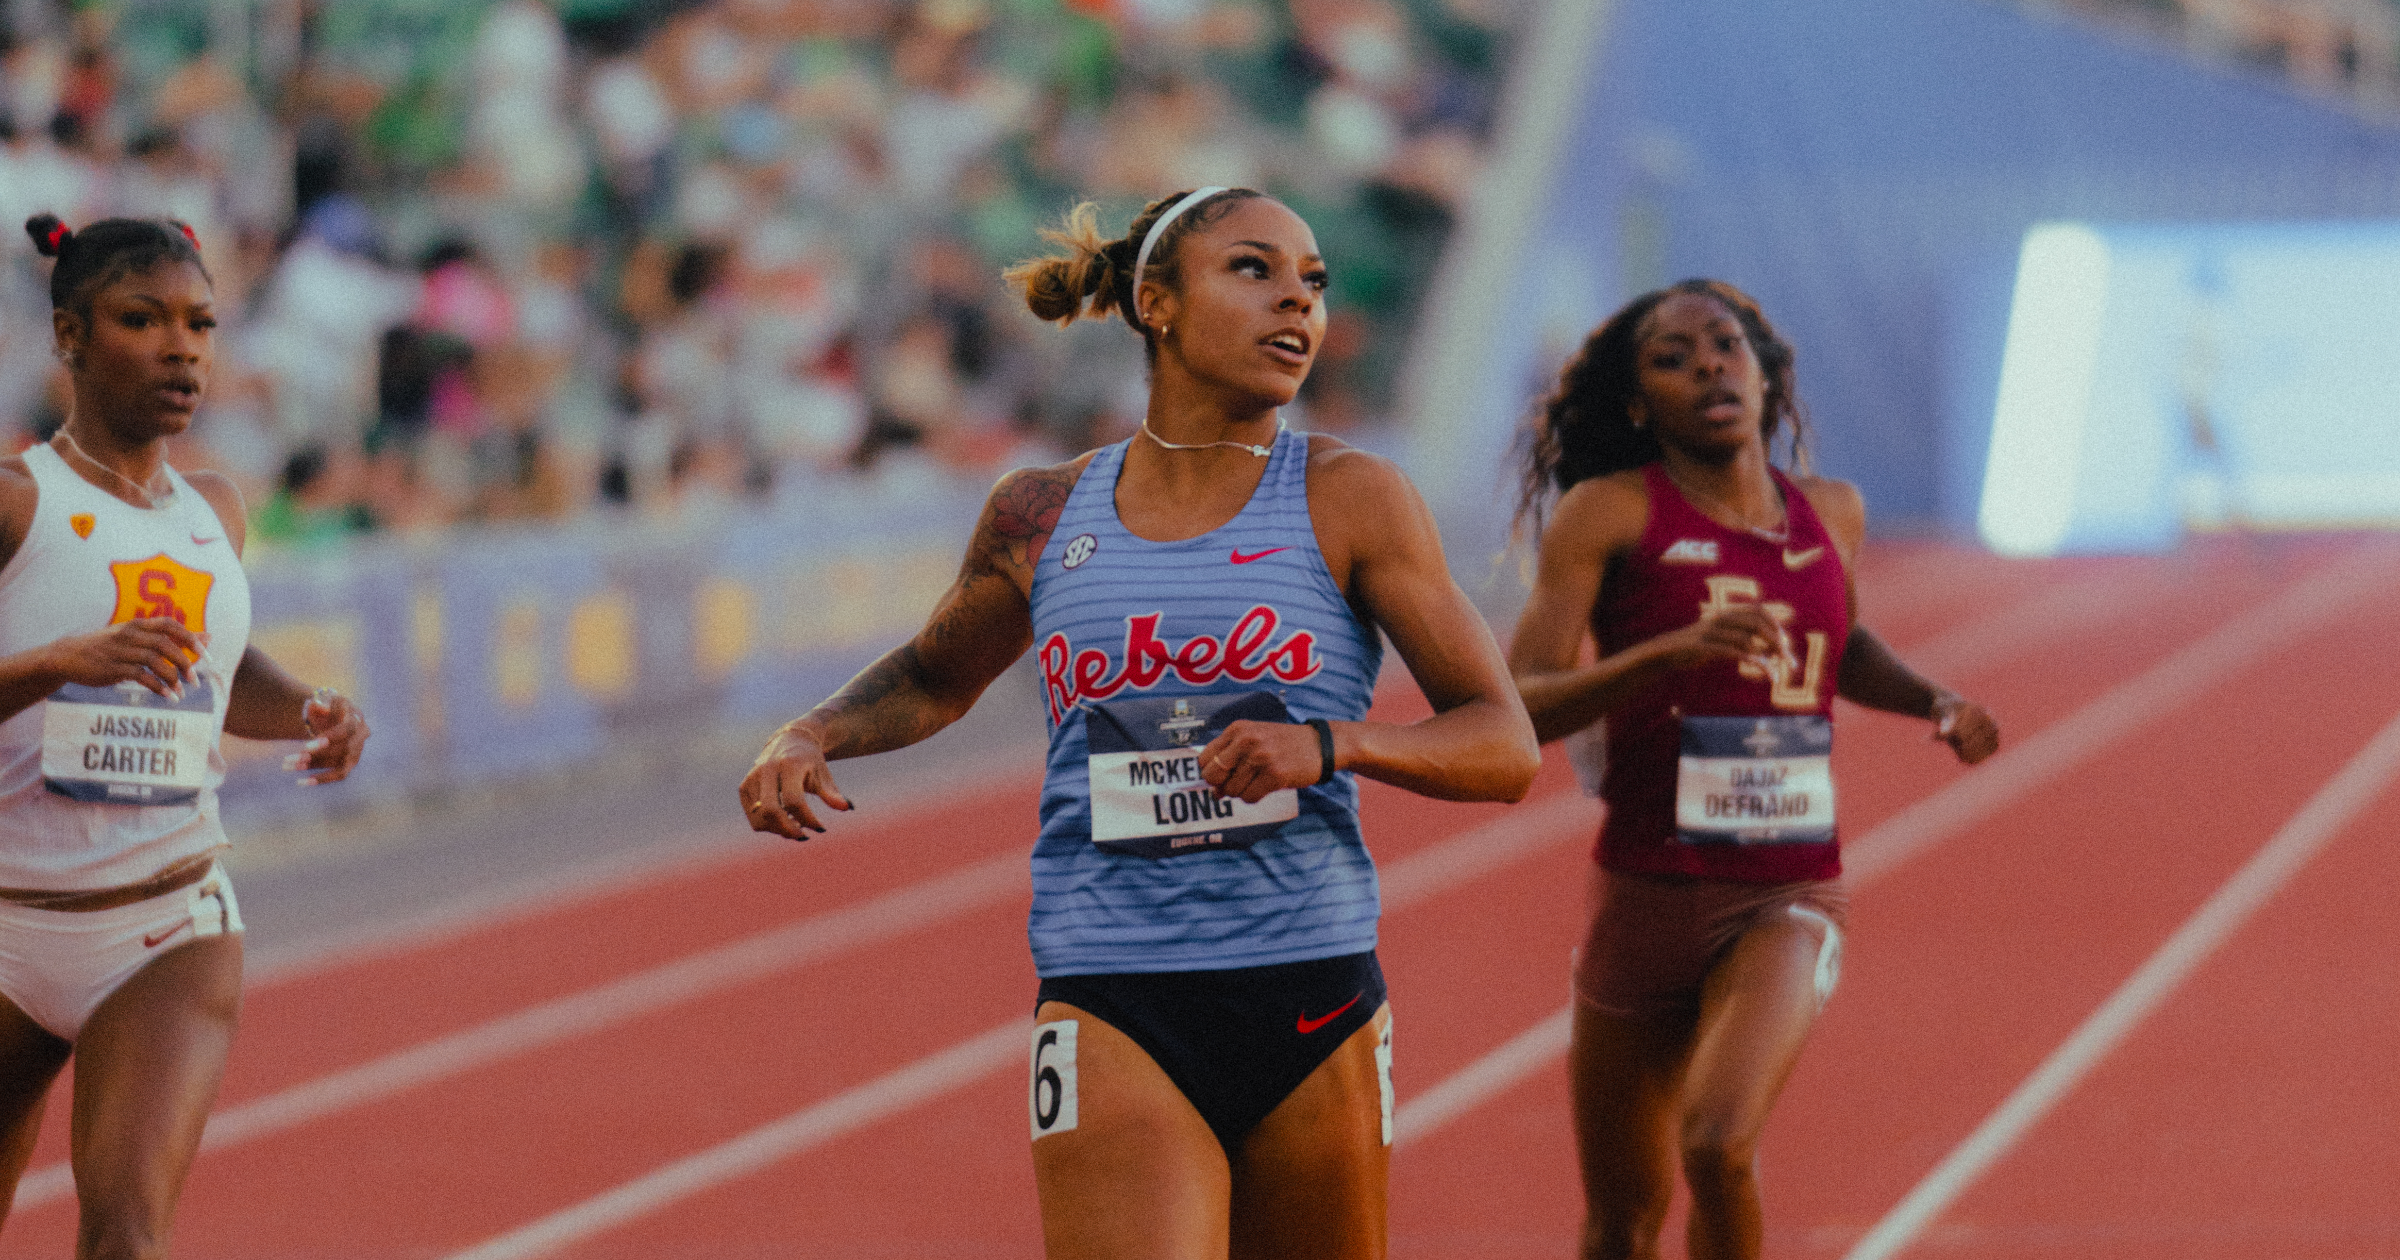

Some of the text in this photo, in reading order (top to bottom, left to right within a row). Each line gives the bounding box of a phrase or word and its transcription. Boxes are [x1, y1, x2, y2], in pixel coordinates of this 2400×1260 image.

[1063, 534, 1097, 569] SEC
[1660, 539, 1720, 565] ACC
[1039, 603, 1323, 727] Rebels
[90, 714, 177, 740] JASSANI
[83, 743, 178, 776] CARTER
[1129, 757, 1204, 787] MCKE
[1730, 766, 1789, 789] DAJAZ
[1153, 789, 1233, 825] LONG
[1704, 793, 1810, 819] DEFRAND
[1035, 1030, 1062, 1130] 6
